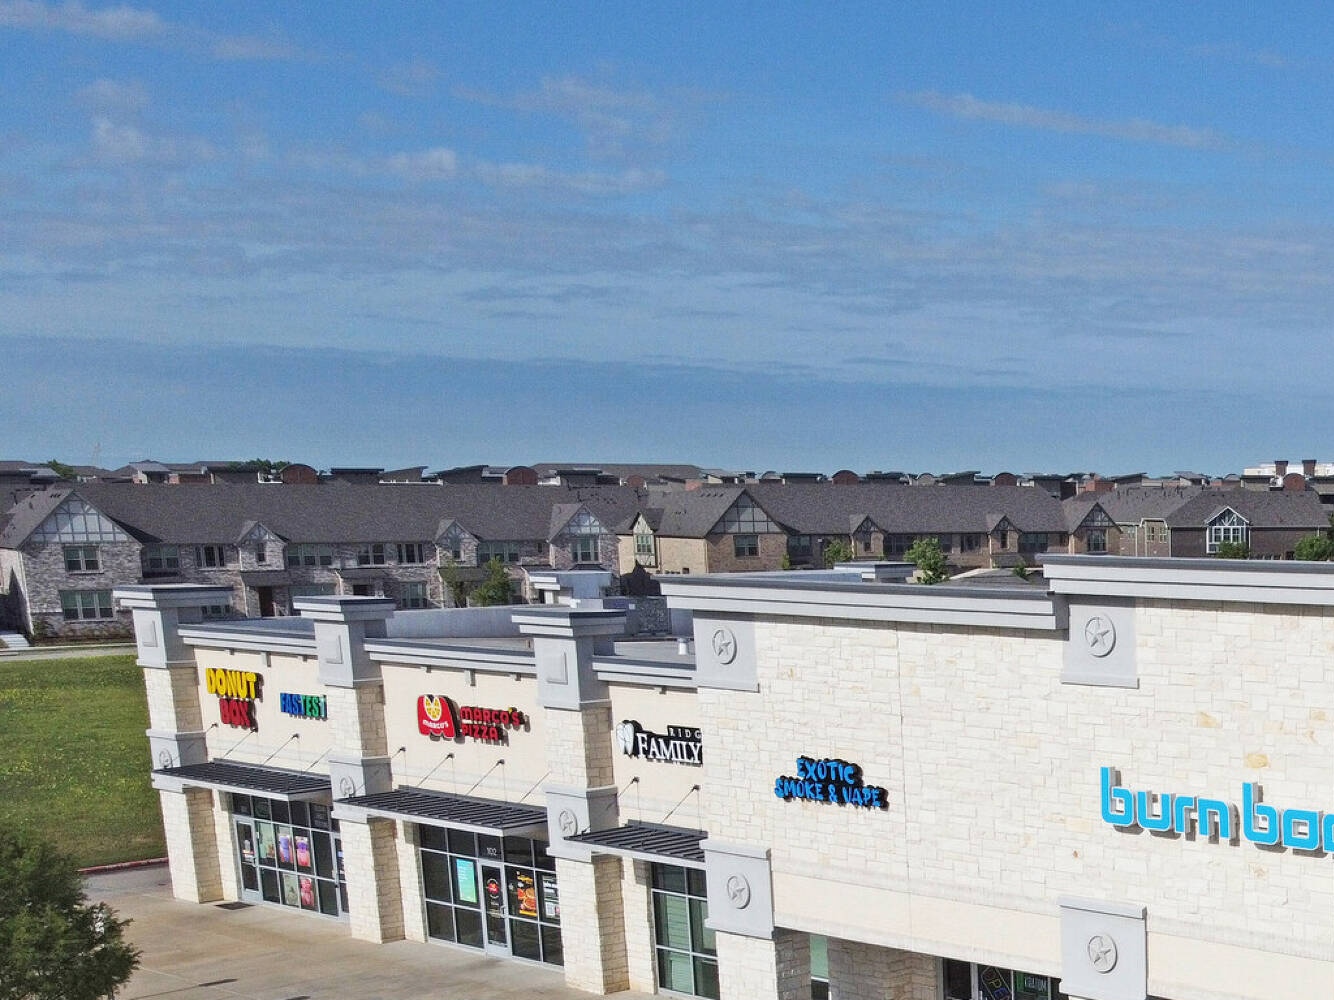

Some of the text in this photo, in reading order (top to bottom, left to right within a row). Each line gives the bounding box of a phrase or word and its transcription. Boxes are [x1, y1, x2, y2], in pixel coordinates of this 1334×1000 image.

[206, 668, 257, 699] DONUT
[220, 698, 250, 728] BOX
[460, 706, 521, 727] MARCO'S
[461, 722, 499, 741] PIZZA
[636, 732, 702, 764] FAMILY
[796, 757, 855, 785] EXOTIC
[774, 777, 881, 808] SMOKE & VAPE
[1100, 766, 1234, 840] burn
